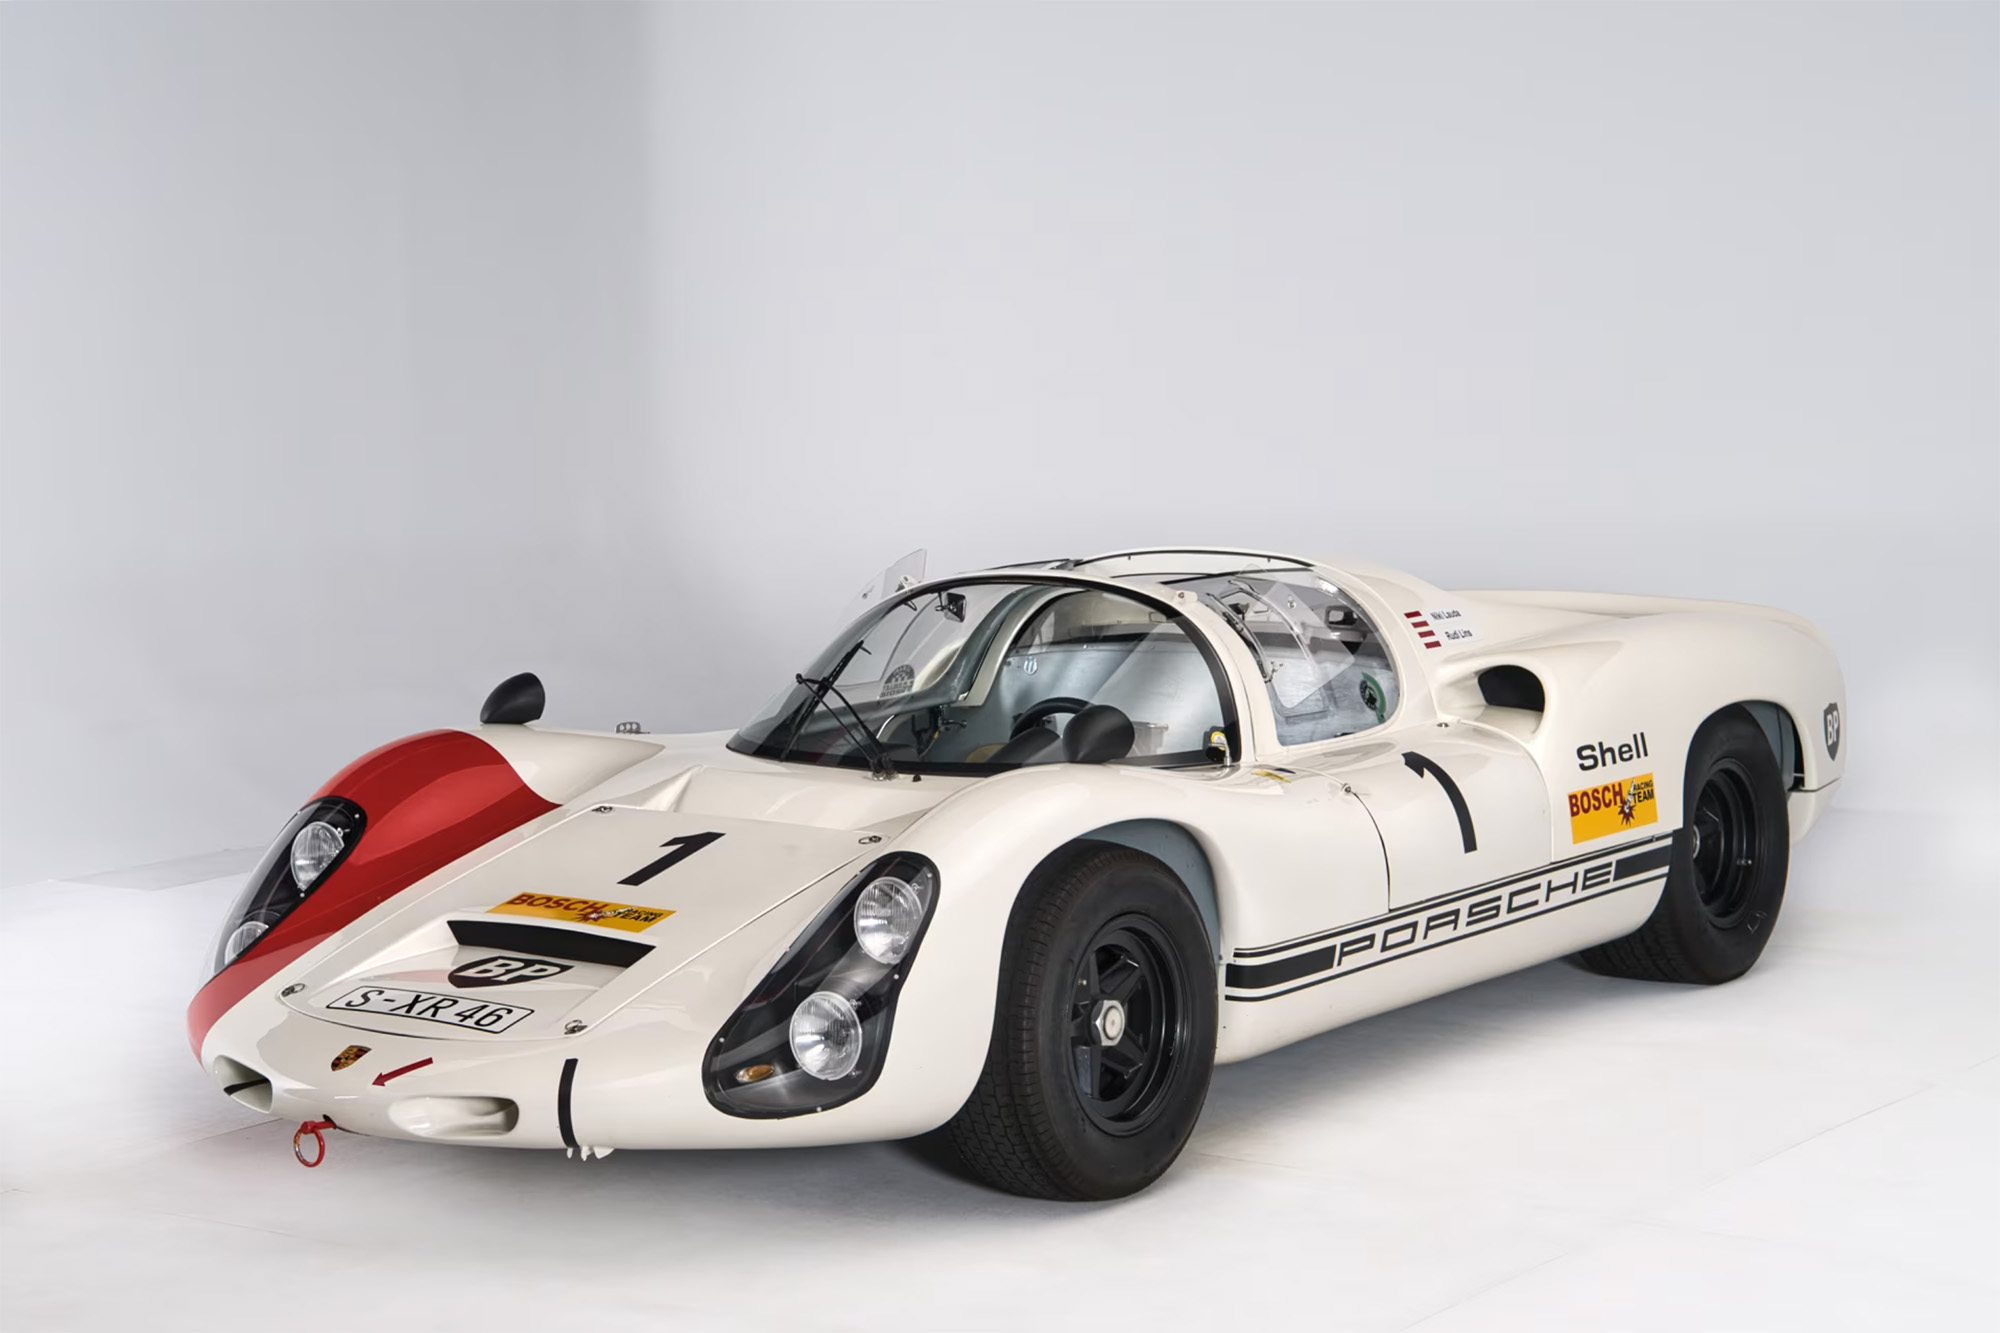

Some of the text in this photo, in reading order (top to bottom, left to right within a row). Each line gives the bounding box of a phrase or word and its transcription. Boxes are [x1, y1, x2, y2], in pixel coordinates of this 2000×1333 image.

[1826, 710, 1839, 746] BP
[1576, 732, 1648, 771] Shell
[1632, 788, 1655, 804] TEAM
[1633, 780, 1654, 791] RACING
[1401, 751, 1477, 854] 1
[1568, 782, 1624, 818] BOSCH
[616, 831, 726, 886] 1
[506, 894, 609, 914] BOSCH
[613, 910, 657, 922] TEAM
[624, 908, 664, 918] RACING
[1337, 861, 1613, 967] PORSCHE
[454, 958, 562, 982] BP
[454, 1004, 513, 1027] 46
